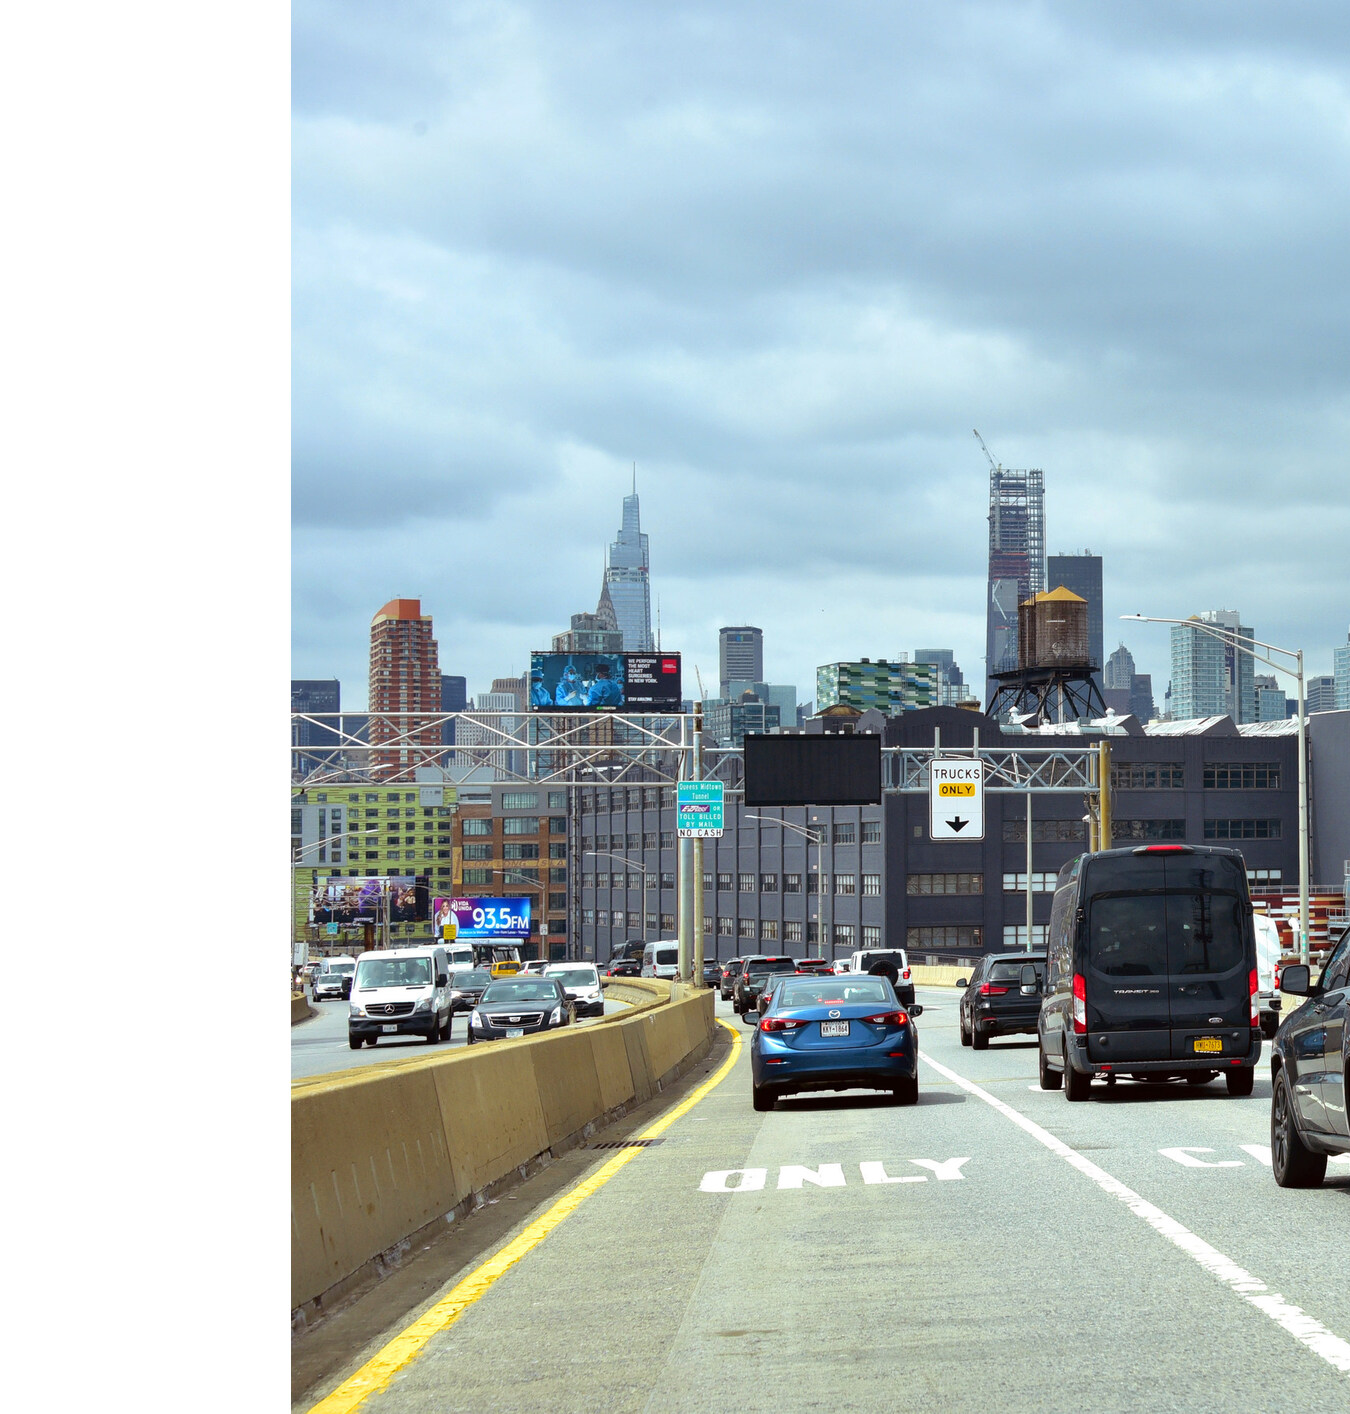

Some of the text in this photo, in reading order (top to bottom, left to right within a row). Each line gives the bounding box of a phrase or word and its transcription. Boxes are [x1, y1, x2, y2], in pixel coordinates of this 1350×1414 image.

[934, 769, 980, 779] TRUCKS
[941, 786, 972, 794] ONLY
[696, 1157, 972, 1193] ONLY
